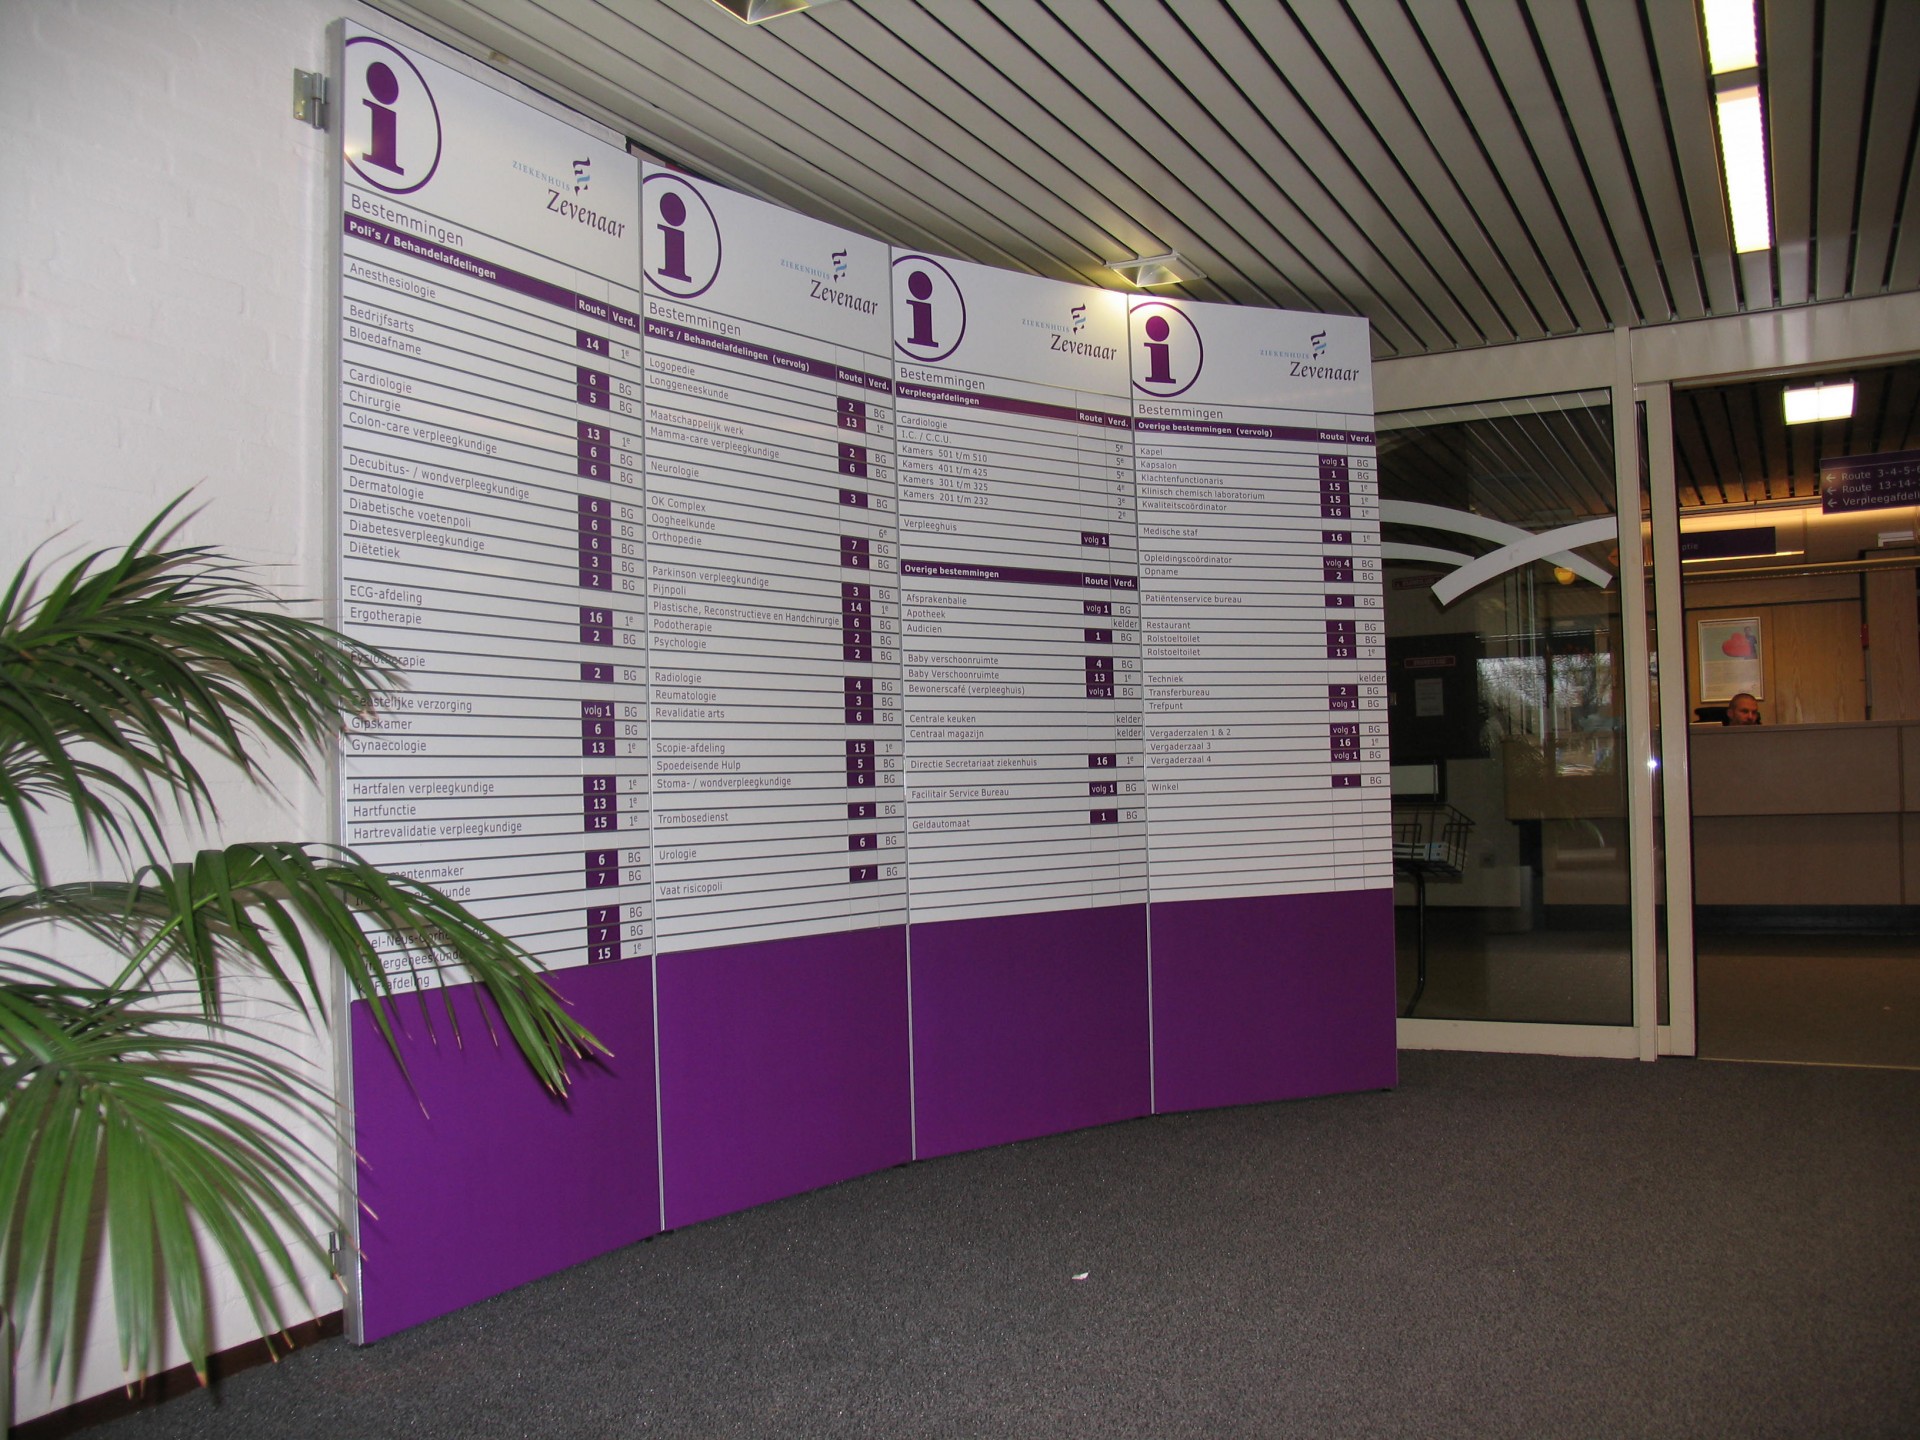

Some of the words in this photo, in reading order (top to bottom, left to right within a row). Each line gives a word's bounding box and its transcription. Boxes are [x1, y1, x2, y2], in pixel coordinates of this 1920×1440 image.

[512, 161, 570, 191] ZIEKENHUIS
[547, 188, 625, 238] Zevenaar
[352, 194, 463, 246] Bestemmingen
[393, 236, 496, 279] Behandelafdelingen
[350, 263, 436, 298] Anesthesiologie
[810, 279, 878, 315] Zevenaar
[579, 300, 606, 317] Route
[350, 305, 414, 333] Bedrijfsarts
[612, 311, 636, 328] Verd.
[649, 302, 741, 336] Bestemmingen
[349, 326, 422, 355] Bloedafname
[586, 338, 599, 350] 14
[684, 333, 768, 361] Behandelafdelingen
[773, 355, 810, 372] (vervolg)
[1050, 334, 1117, 361] Zevenaar
[649, 358, 695, 376] Logopedie
[1289, 361, 1359, 382] Zevenaar
[349, 368, 412, 394] Cardiologie
[590, 375, 596, 385] 6
[839, 371, 863, 384] Route
[868, 377, 889, 391] Verd.
[900, 368, 985, 390] Bestemmingen
[650, 375, 729, 400] Longgeneeskunde
[349, 390, 401, 411] Chirurgie
[899, 386, 980, 405] Verpleegafdelingen
[1080, 413, 1103, 424] Route
[1138, 404, 1223, 420] Bestemmingen
[650, 410, 720, 432] Maatschappelijk
[723, 424, 744, 436] werk
[901, 416, 948, 429] Cardiologie
[1108, 417, 1129, 427] Verd.
[349, 412, 410, 434] Colon-care
[413, 426, 497, 454] verpleegkundige
[1138, 421, 1171, 432] Overige
[1172, 423, 1232, 434] bestemmingen
[1236, 427, 1273, 438] (vervolg)
[650, 427, 709, 446] Mamma-care
[711, 437, 779, 459] verpleegkundige
[1320, 432, 1344, 441] Route
[1350, 434, 1372, 443] Verd.
[902, 445, 933, 456] Kamers
[938, 450, 952, 459] 501
[956, 451, 969, 461] t/m
[973, 453, 988, 462] 510
[1140, 448, 1163, 456] Kapel
[651, 461, 699, 478] Neurologie
[902, 460, 933, 471] Kamers
[938, 465, 952, 473] 401
[956, 466, 970, 475] t/m
[972, 468, 988, 477] 425
[1140, 461, 1177, 469] Kapsalon
[349, 454, 409, 475] Decubitus-
[421, 469, 530, 499] wondverpleegkundige
[1141, 474, 1224, 485] Klachtenfunctionaris
[1841, 471, 1871, 481] Route
[349, 476, 424, 500] Dermatologie
[903, 475, 934, 486] Kamers
[939, 479, 953, 488] 301
[956, 480, 971, 489] t/m
[973, 482, 988, 491] 325
[1842, 484, 1872, 493] Route
[903, 490, 934, 500] Kamers
[939, 493, 953, 502] 201
[957, 495, 972, 504] t/m
[974, 497, 989, 505] 232
[1142, 488, 1173, 496] Klinisch
[1175, 489, 1212, 497] chemisch
[1214, 491, 1265, 500] laboratorium
[651, 496, 664, 506] OK
[667, 499, 706, 513] Complex
[349, 498, 414, 518] Diabetische
[418, 510, 471, 528] voetenpoli
[652, 514, 715, 531] Oogheelkunde
[904, 519, 957, 532] Verpleeghuis
[349, 519, 485, 551] Diabetesverpleegkundige
[652, 531, 702, 546] Orthopedie
[1144, 527, 1180, 536] Medische
[1183, 529, 1198, 537] staf
[349, 541, 400, 558] Diëtetiek
[653, 567, 697, 579] Parkinson
[699, 573, 769, 588] verpleegkundige
[905, 564, 938, 575] Overige
[940, 566, 999, 578] bestemmingen
[1144, 568, 1178, 576] Opname
[1085, 576, 1109, 586] Route
[1114, 578, 1134, 587] Verd.
[350, 585, 423, 605] ECG-afdeling
[653, 584, 686, 596] Pijnpoli
[906, 594, 967, 605] Afsprakenbalie
[1214, 595, 1242, 604] bureau
[350, 607, 422, 625] Ergotherapie
[653, 602, 701, 616] Plastische,
[704, 606, 771, 620] Reconstructieve
[786, 613, 840, 626] Handchirurgie
[907, 609, 946, 619] Apotheek
[654, 619, 712, 632] Podotherapie
[907, 624, 942, 633] Audicien
[654, 637, 707, 650] Psychologie
[1147, 635, 1200, 643] Rolstoeltoilet
[1147, 648, 1201, 656] Rolstoeltoilet
[908, 654, 928, 663] Baby
[931, 655, 998, 665] verschoonruimte
[655, 672, 701, 684] Radiologie
[908, 669, 929, 678] Baby
[932, 670, 999, 679] Verschoonruimte
[1148, 675, 1183, 683] Techniek
[1359, 674, 1385, 682] kelder
[655, 690, 716, 702] Reumatologie
[909, 684, 966, 694] Bewonerscafé
[968, 686, 1025, 695] (verpleeghuis)
[1149, 688, 1210, 697] Transferbureau
[417, 699, 472, 712] verzorging
[584, 704, 602, 717] volg
[1149, 702, 1183, 711] Trefpunt
[656, 708, 705, 718] Revalidatie
[708, 710, 725, 718] arts
[1116, 714, 1141, 724] kelder
[351, 716, 412, 731] Gipskamer
[910, 730, 945, 738] Centraal
[948, 730, 984, 739] magazijn
[1116, 728, 1141, 738] kelder
[1150, 729, 1209, 738] Vergaderzalen
[352, 739, 426, 753] Gynaecologie
[656, 743, 725, 754] Scopie-afdeling
[1150, 742, 1204, 752] Vergaderzaal
[656, 761, 719, 771] Spoedeisende
[721, 761, 741, 771] Hulp
[910, 760, 943, 769] Directie
[945, 759, 994, 768] Secretariaat
[997, 758, 1037, 767] ziekenhuis
[1151, 755, 1204, 765] Vergaderzaal
[353, 783, 405, 795] Hartfalen
[409, 781, 495, 796] verpleegkundige
[657, 779, 690, 788] Stoma-
[700, 777, 791, 788] wondverpleegkundige
[1152, 783, 1179, 791] Winkel
[912, 790, 947, 799] Facilitair
[949, 790, 979, 798] Service
[981, 789, 1009, 797] Bureau
[353, 805, 416, 817] Hartfunctie
[658, 813, 729, 824] Trombosedienst
[912, 819, 970, 829] Geldautomaat
[354, 825, 437, 839] Hartrevalidatie
[440, 822, 522, 835] verpleegkundige
[659, 850, 697, 860] Urologie
[660, 886, 680, 896] Vaat
[683, 882, 723, 894] risicopoli
